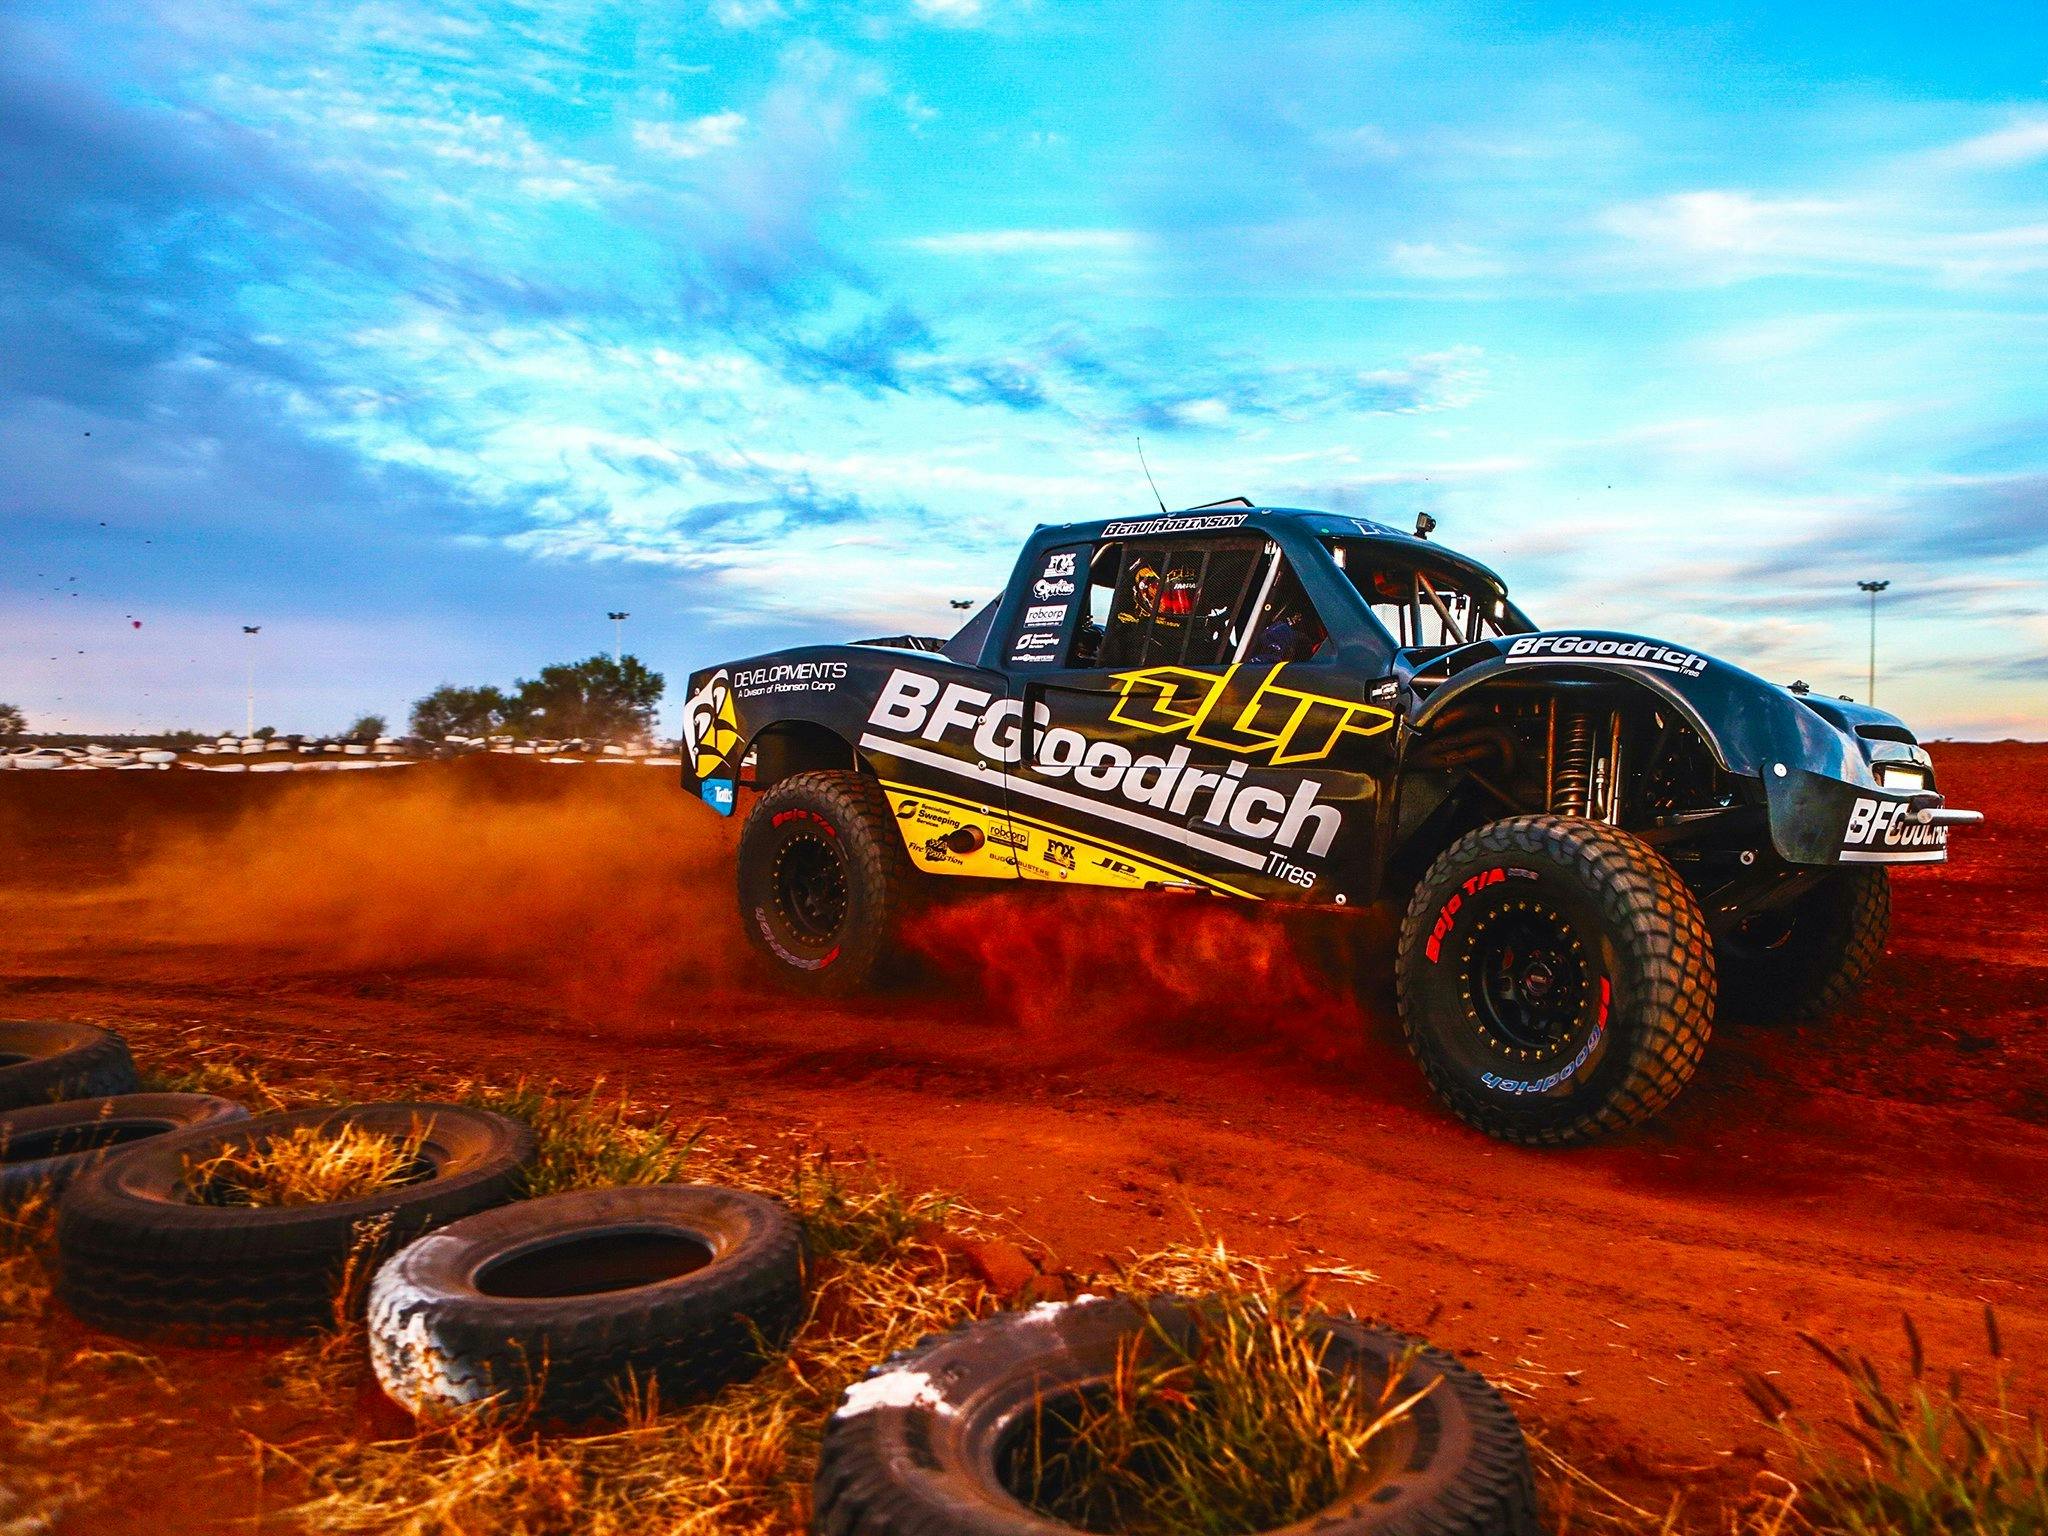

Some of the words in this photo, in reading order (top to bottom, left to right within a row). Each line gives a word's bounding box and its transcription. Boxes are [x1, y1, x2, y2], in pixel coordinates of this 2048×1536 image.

[1102, 522, 1152, 537] BEAU
[1150, 514, 1248, 534] ROBINSON
[1028, 608, 1064, 619] robcorp
[1507, 637, 1708, 671] BFGoodrich
[734, 662, 848, 688] DEVELOPMENTS
[1678, 665, 1700, 677] Tires
[774, 683, 810, 693] Robinson
[811, 681, 836, 692] Corp
[867, 668, 1342, 858] BFGoodrich
[918, 809, 960, 829] Sweeping
[990, 825, 1026, 843] robcorp
[1047, 838, 1075, 862] FOX
[1267, 850, 1317, 889] Tires
